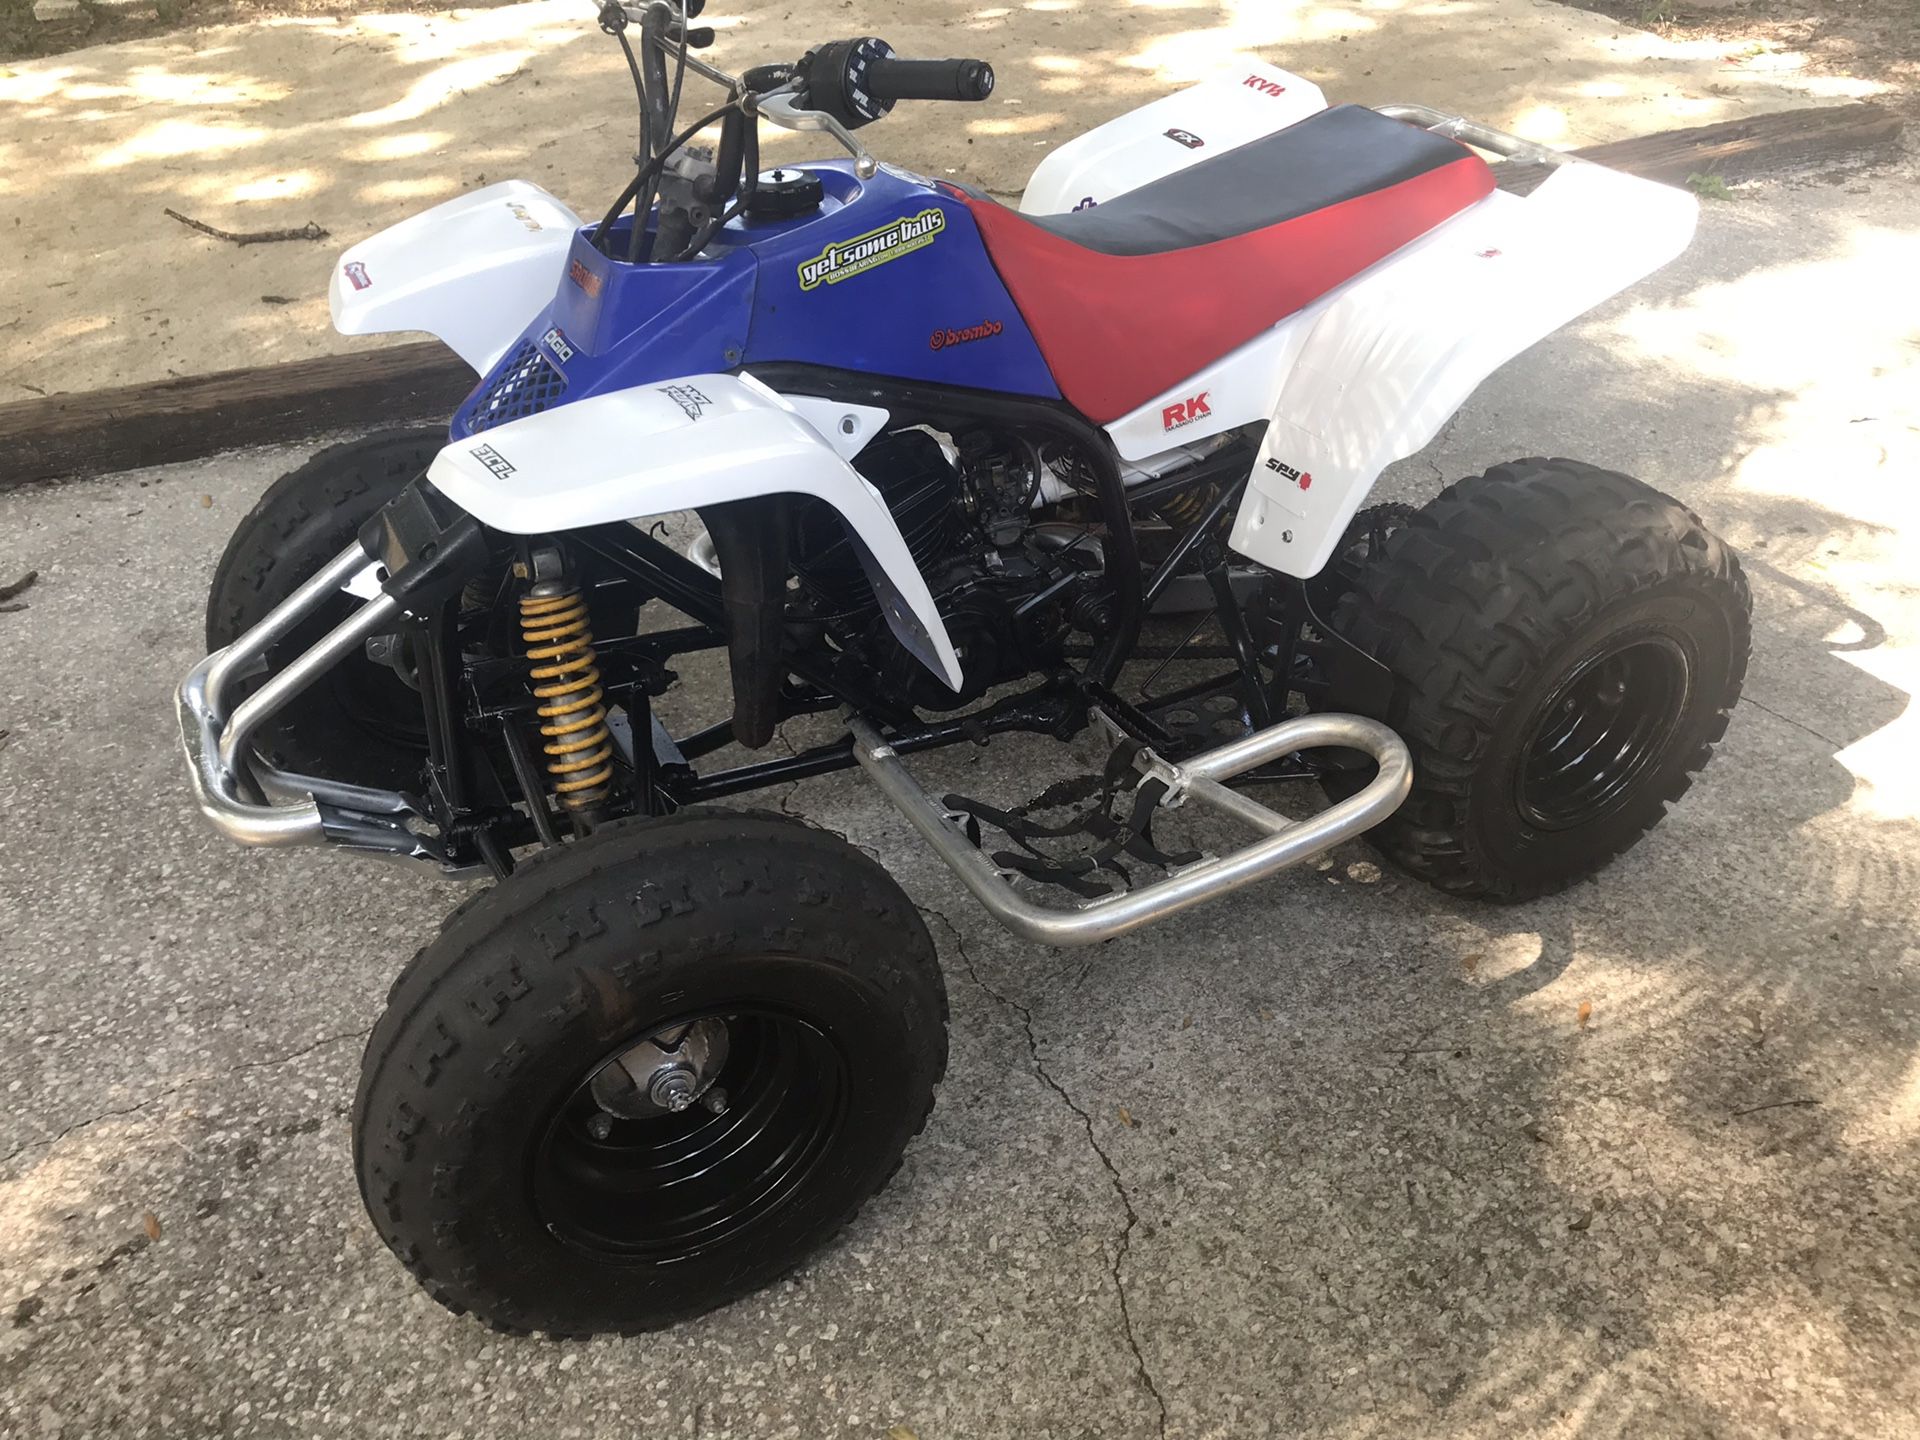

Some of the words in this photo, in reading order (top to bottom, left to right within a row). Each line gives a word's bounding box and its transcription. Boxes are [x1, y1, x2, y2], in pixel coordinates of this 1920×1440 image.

[1242, 75, 1286, 97] KYB
[803, 248, 839, 285] get
[842, 228, 899, 266] some
[899, 212, 942, 242] balls
[945, 320, 1001, 346] brembo
[1162, 391, 1210, 428] RK
[470, 443, 516, 480] EXCEL
